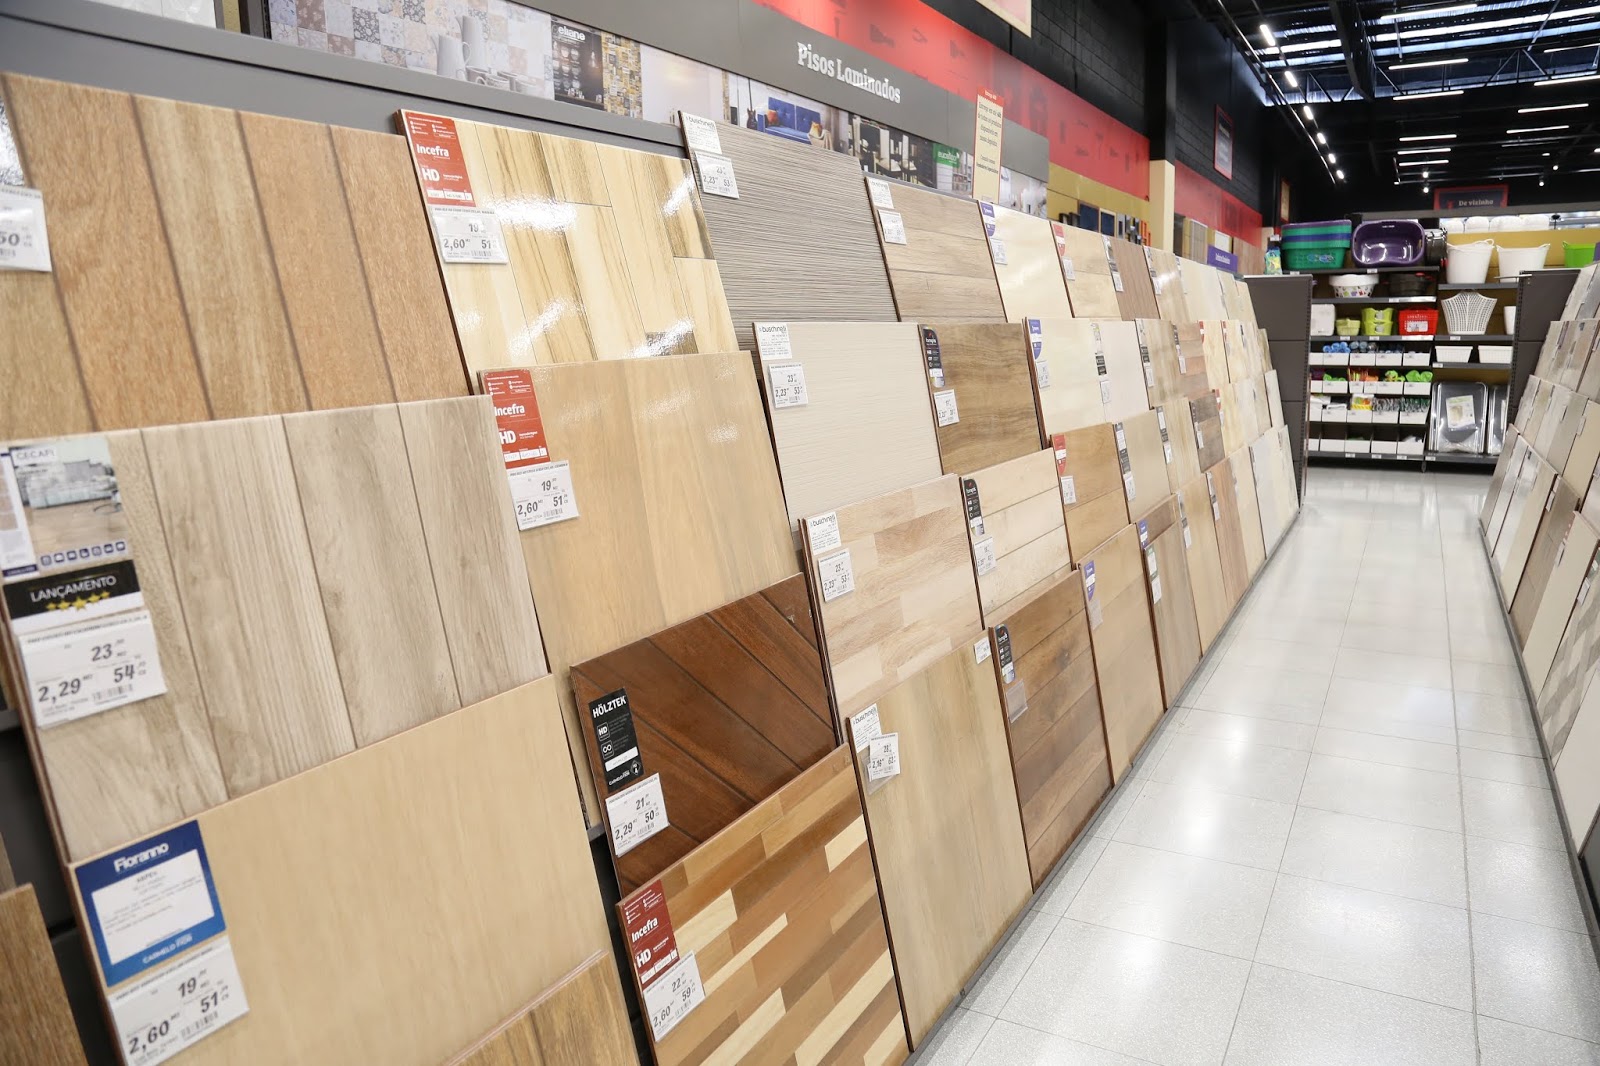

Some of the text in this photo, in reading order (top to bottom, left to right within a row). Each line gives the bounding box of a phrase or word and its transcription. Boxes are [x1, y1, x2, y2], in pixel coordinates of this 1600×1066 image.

[558, 26, 586, 40] eliane
[797, 42, 900, 104] Pisos Laminados
[416, 144, 449, 157] Incefra
[421, 168, 440, 182] HD
[468, 223, 479, 233] 19
[444, 238, 491, 250] 2,60 51
[794, 386, 801, 394] 53
[494, 403, 525, 416] Incefra
[500, 430, 516, 445] HD
[541, 480, 552, 492] 19
[517, 501, 538, 517] 2,60
[553, 495, 563, 507] 51
[841, 574, 847, 584] 53
[30, 574, 118, 604] LANÇAMENTO
[91, 643, 113, 662] 23
[38, 678, 81, 703] 2,29
[113, 663, 136, 683] 54
[592, 695, 626, 718] HÖLZTEK
[598, 726, 608, 736] HD
[636, 798, 645, 811] 21
[615, 809, 655, 840] 2,29 50
[114, 842, 169, 873] Fioranno
[632, 917, 658, 943] Incefra
[636, 948, 652, 968] HD
[178, 977, 197, 998] 19
[671, 978, 681, 993] 22
[653, 987, 691, 1028] 2,60 59
[128, 1019, 170, 1055] 2,60
[200, 991, 219, 1014] 51
